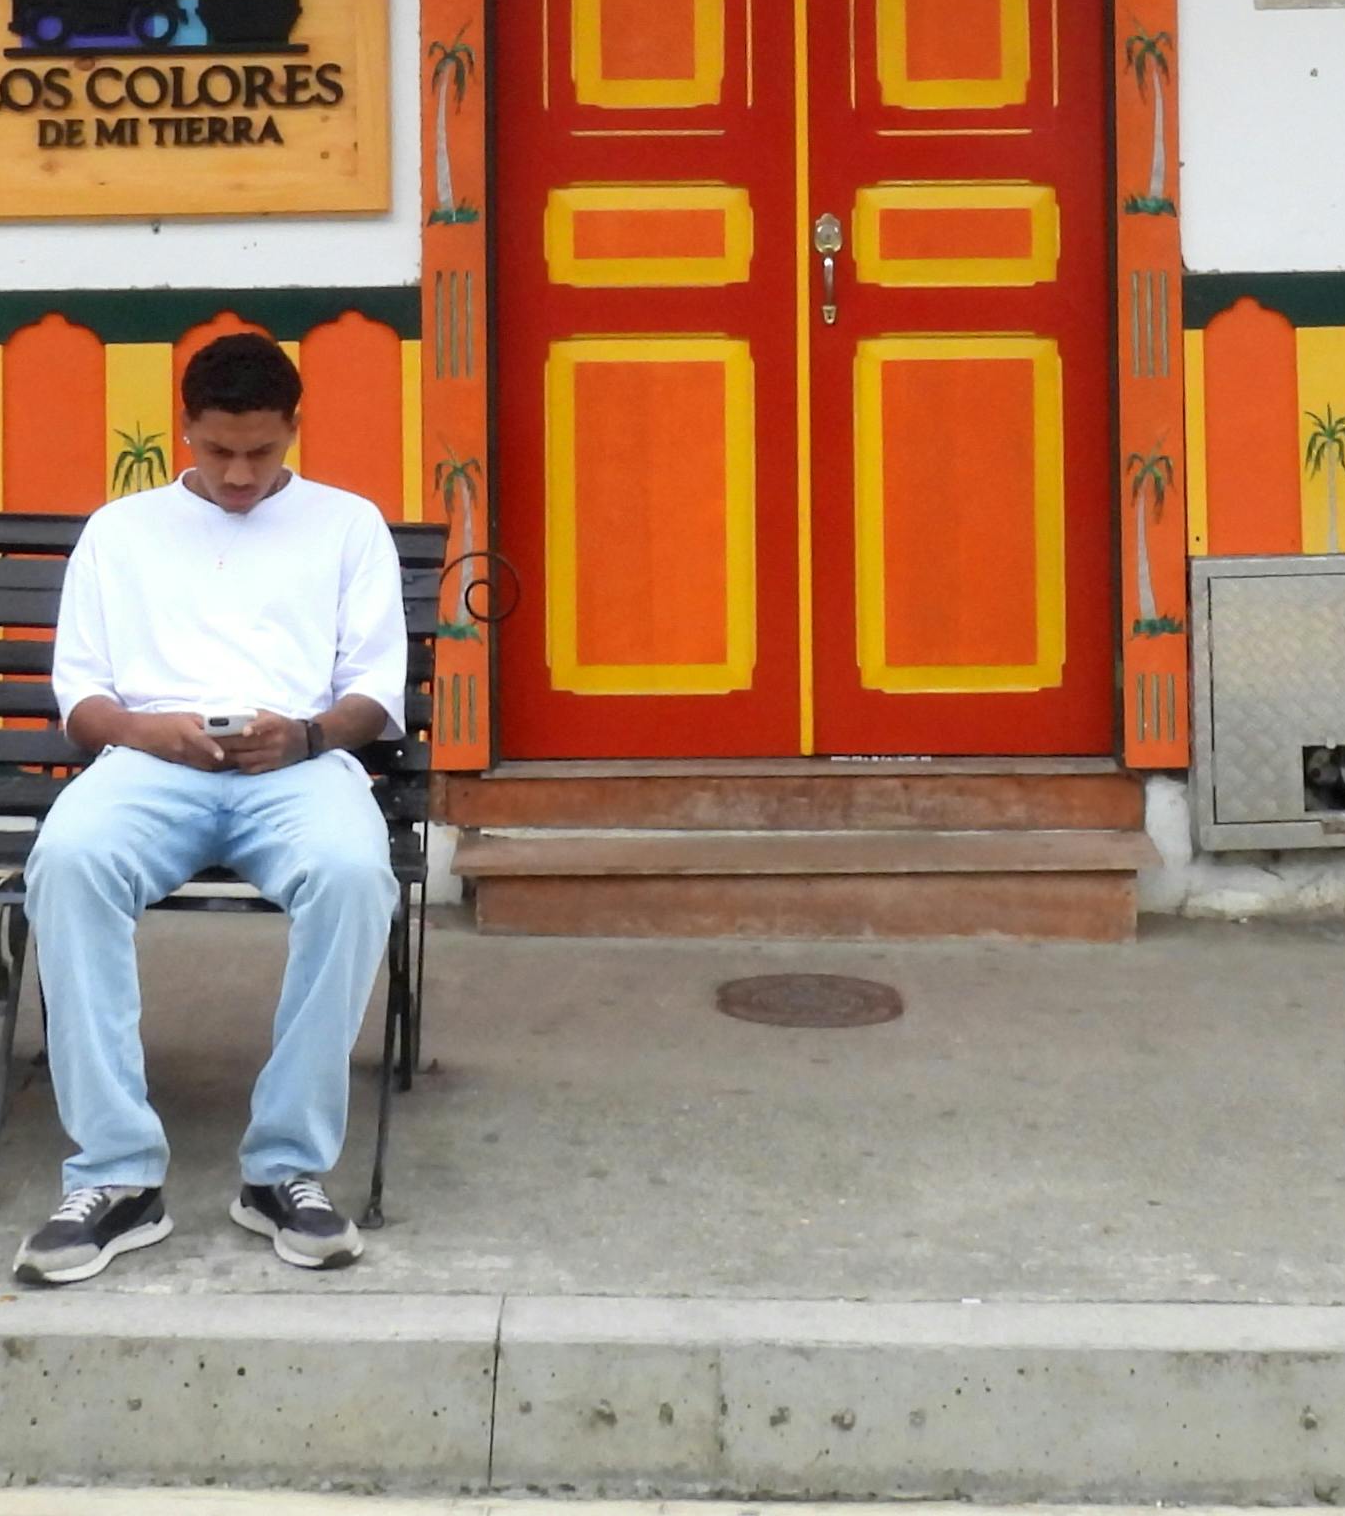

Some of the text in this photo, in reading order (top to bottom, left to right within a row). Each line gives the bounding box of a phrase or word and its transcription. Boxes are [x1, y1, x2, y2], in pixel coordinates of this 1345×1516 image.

[86, 63, 345, 110] COLORES
[38, 115, 284, 148] DE MI TIERRA
